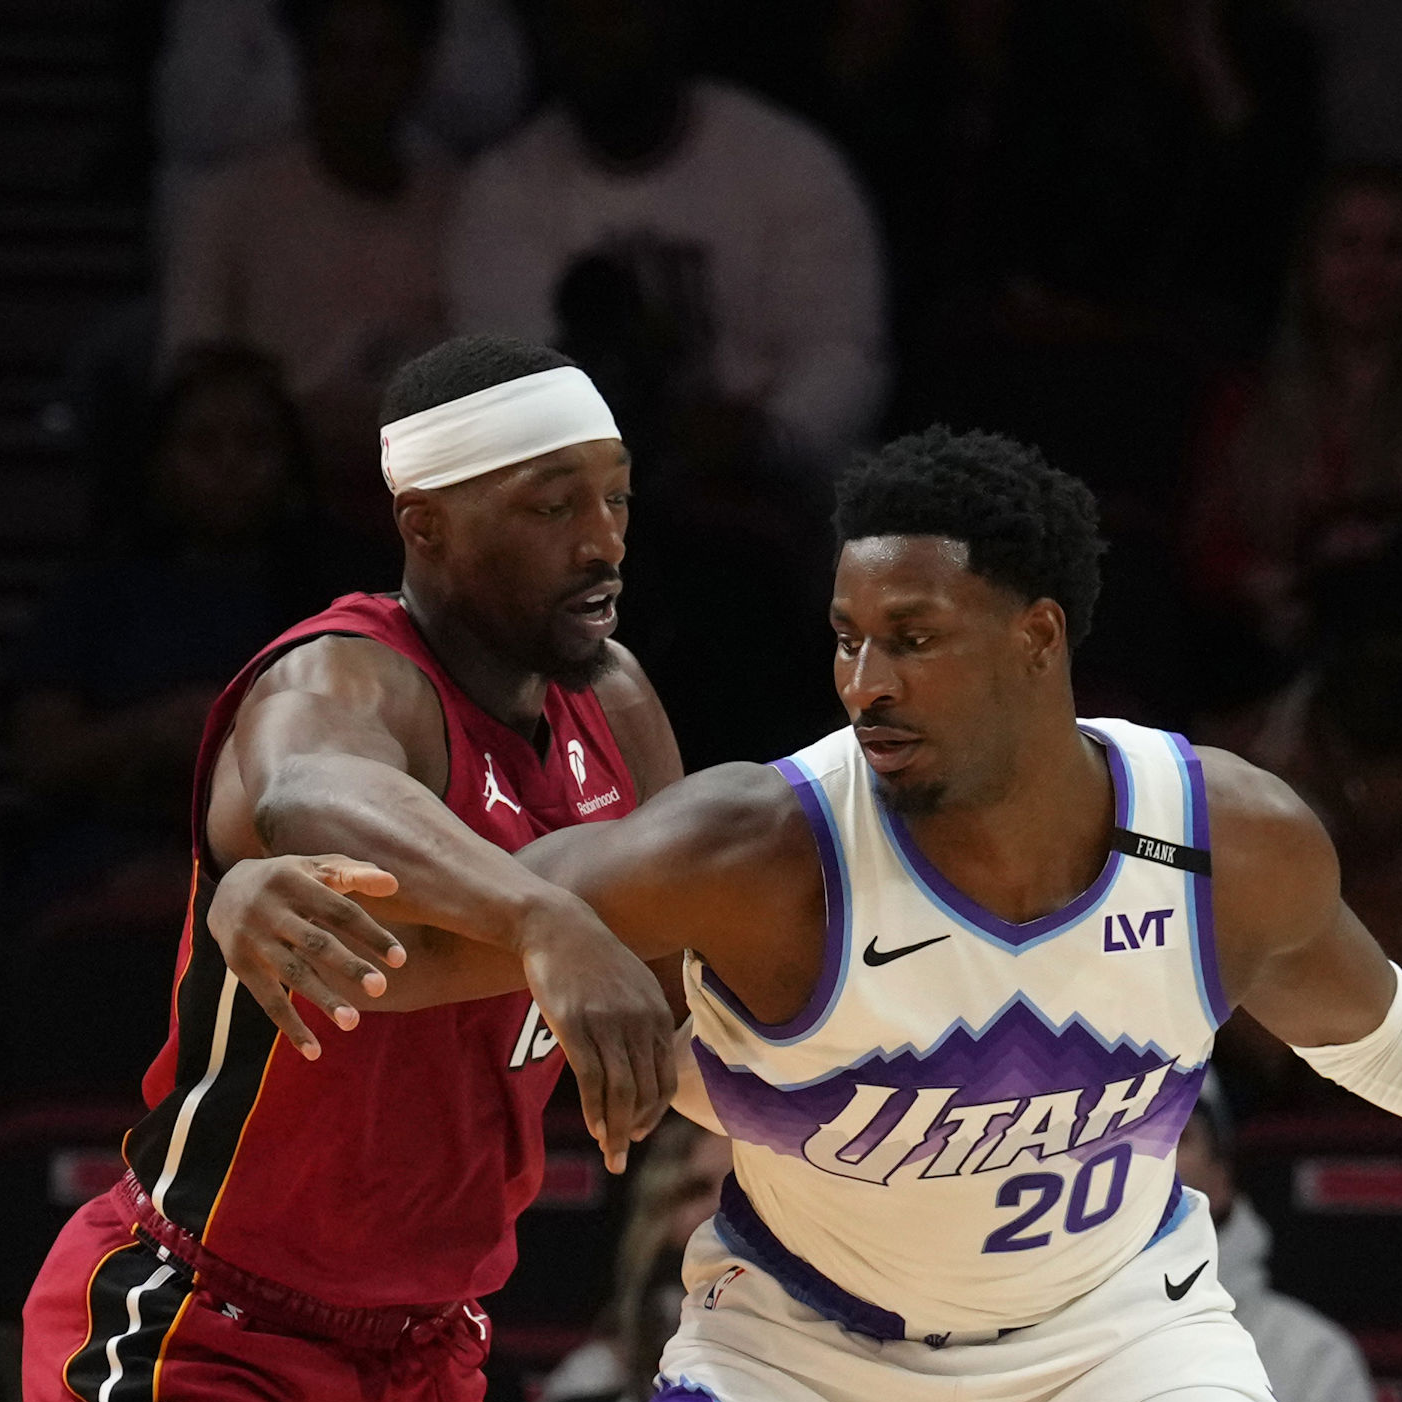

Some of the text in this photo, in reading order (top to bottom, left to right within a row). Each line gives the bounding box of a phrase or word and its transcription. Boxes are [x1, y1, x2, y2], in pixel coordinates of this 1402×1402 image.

[576, 785, 621, 817] Robinhood
[1136, 837, 1177, 864] FRANK
[1104, 909, 1174, 952] LVT
[802, 1055, 1180, 1186] UTAH
[982, 1143, 1133, 1254] 20
